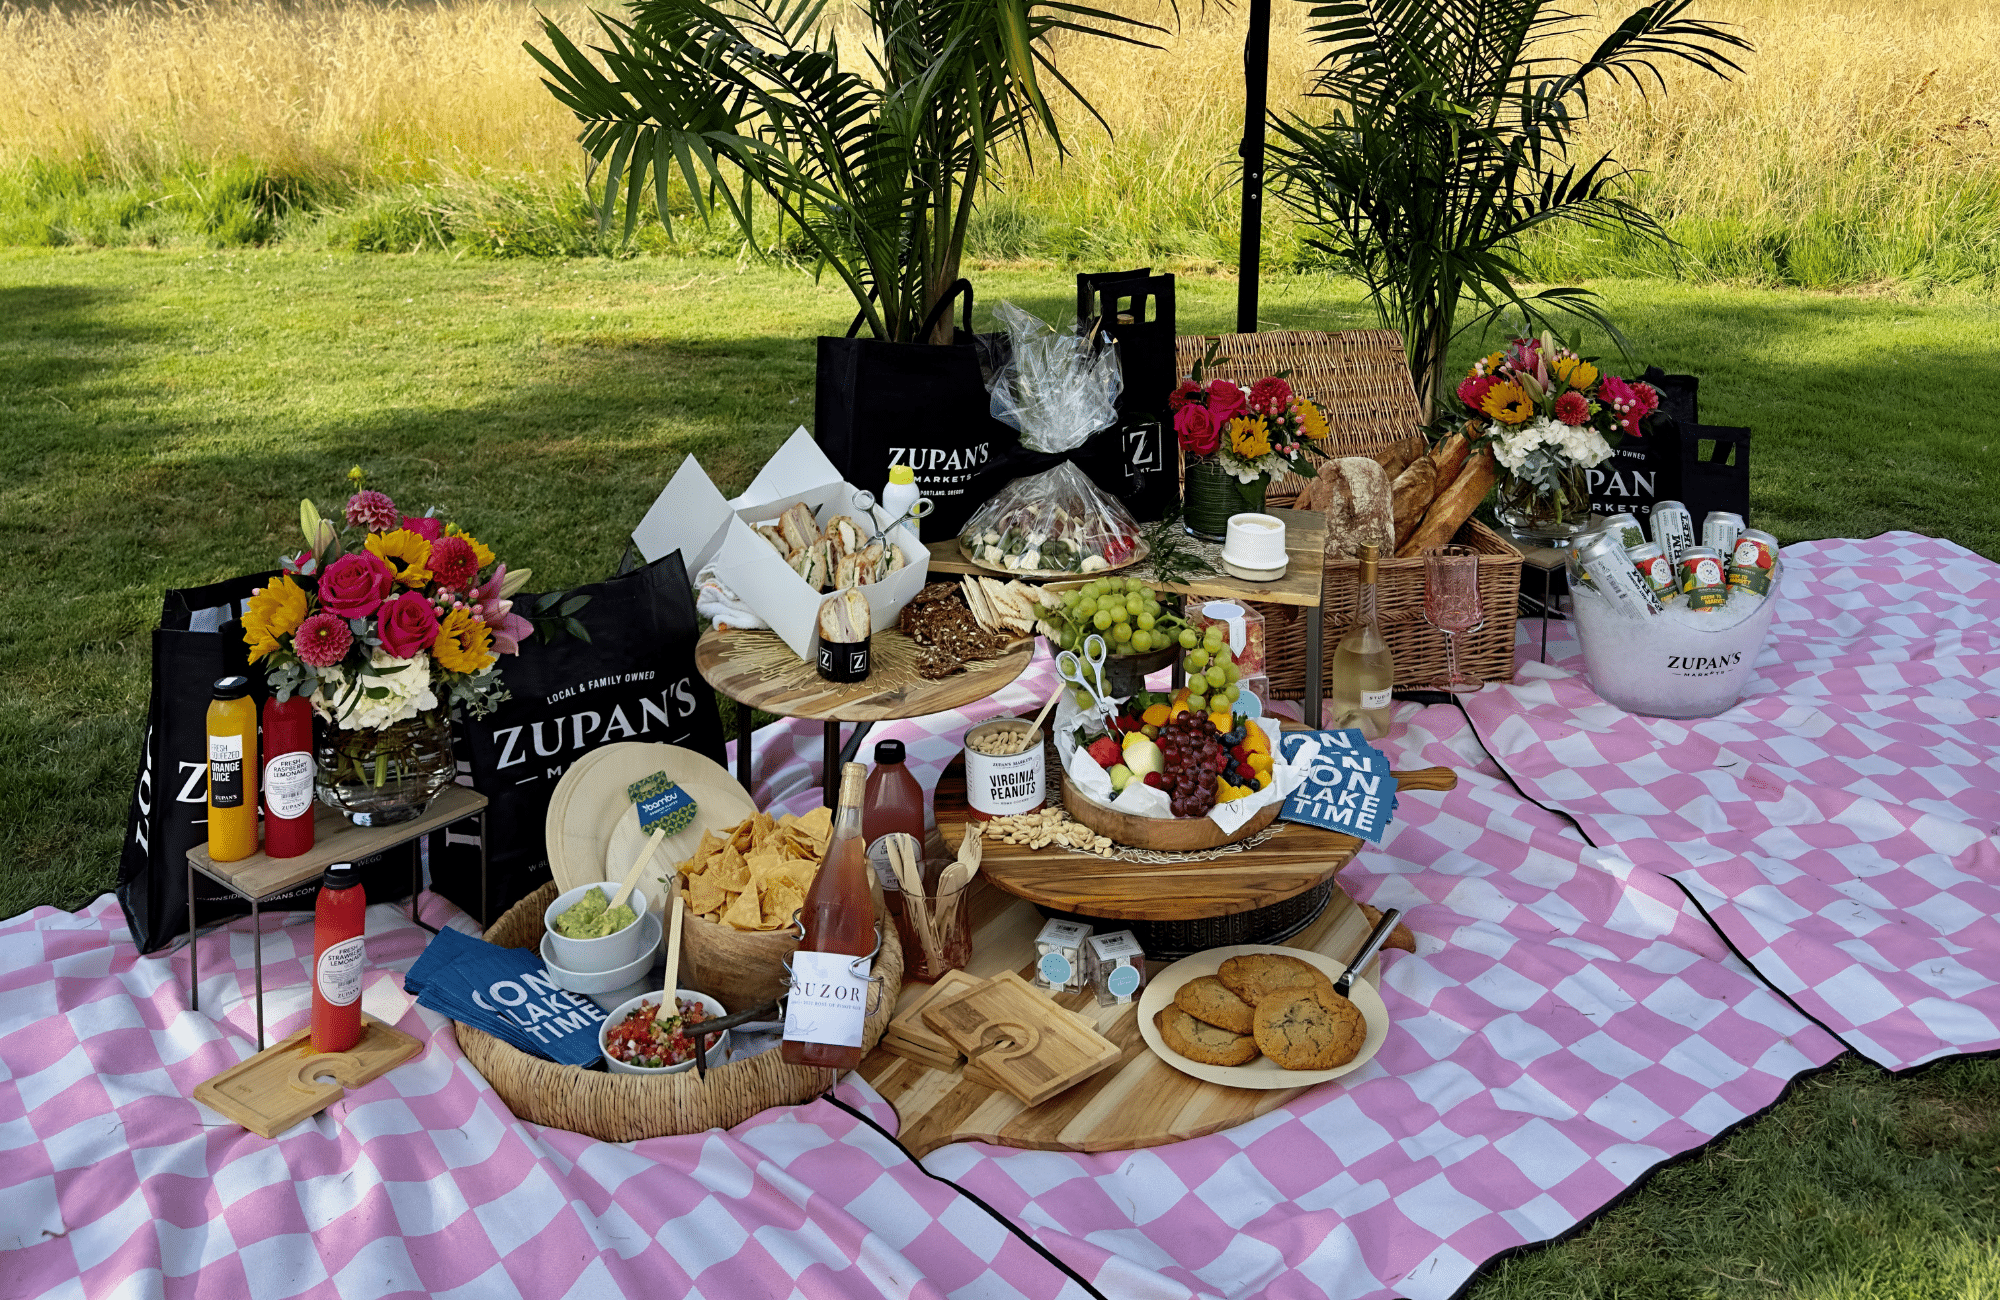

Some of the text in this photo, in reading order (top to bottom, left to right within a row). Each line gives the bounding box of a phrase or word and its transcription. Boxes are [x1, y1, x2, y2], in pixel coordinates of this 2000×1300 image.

[887, 442, 989, 470] ZUPAN'S
[1130, 430, 1153, 465] Z
[1622, 450, 1645, 460] OWNED
[913, 473, 972, 483] MARKETS
[1585, 469, 1656, 497] PAN
[1592, 503, 1650, 513] RKETS
[821, 650, 830, 667] Z
[853, 654, 864, 669] Z
[1667, 651, 1742, 670] ZUPAN'S
[547, 670, 656, 705] LOCAL & FAMILY OWNED
[493, 677, 697, 770] ZUPAN'S
[211, 744, 228, 752] FRESH
[212, 751, 240, 760] SQUEEZED
[211, 761, 240, 772] ORANGE
[273, 761, 308, 772] RASPBERRY
[273, 766, 308, 778] LEMONADE
[280, 759, 301, 767] FRESH
[211, 772, 230, 781] JUICE
[989, 769, 1034, 787] VIRGINIA
[1308, 764, 1381, 796] ON
[990, 781, 1036, 800] PEANUTS
[1296, 781, 1380, 815] LAKE
[646, 792, 678, 811] bambu
[1293, 797, 1376, 832] TIME
[357, 854, 382, 867] WEGO
[339, 944, 359, 954] FRESH
[794, 982, 861, 1003] SUZOR
[506, 990, 586, 1026] LAKE
[524, 1003, 608, 1044] TIME
